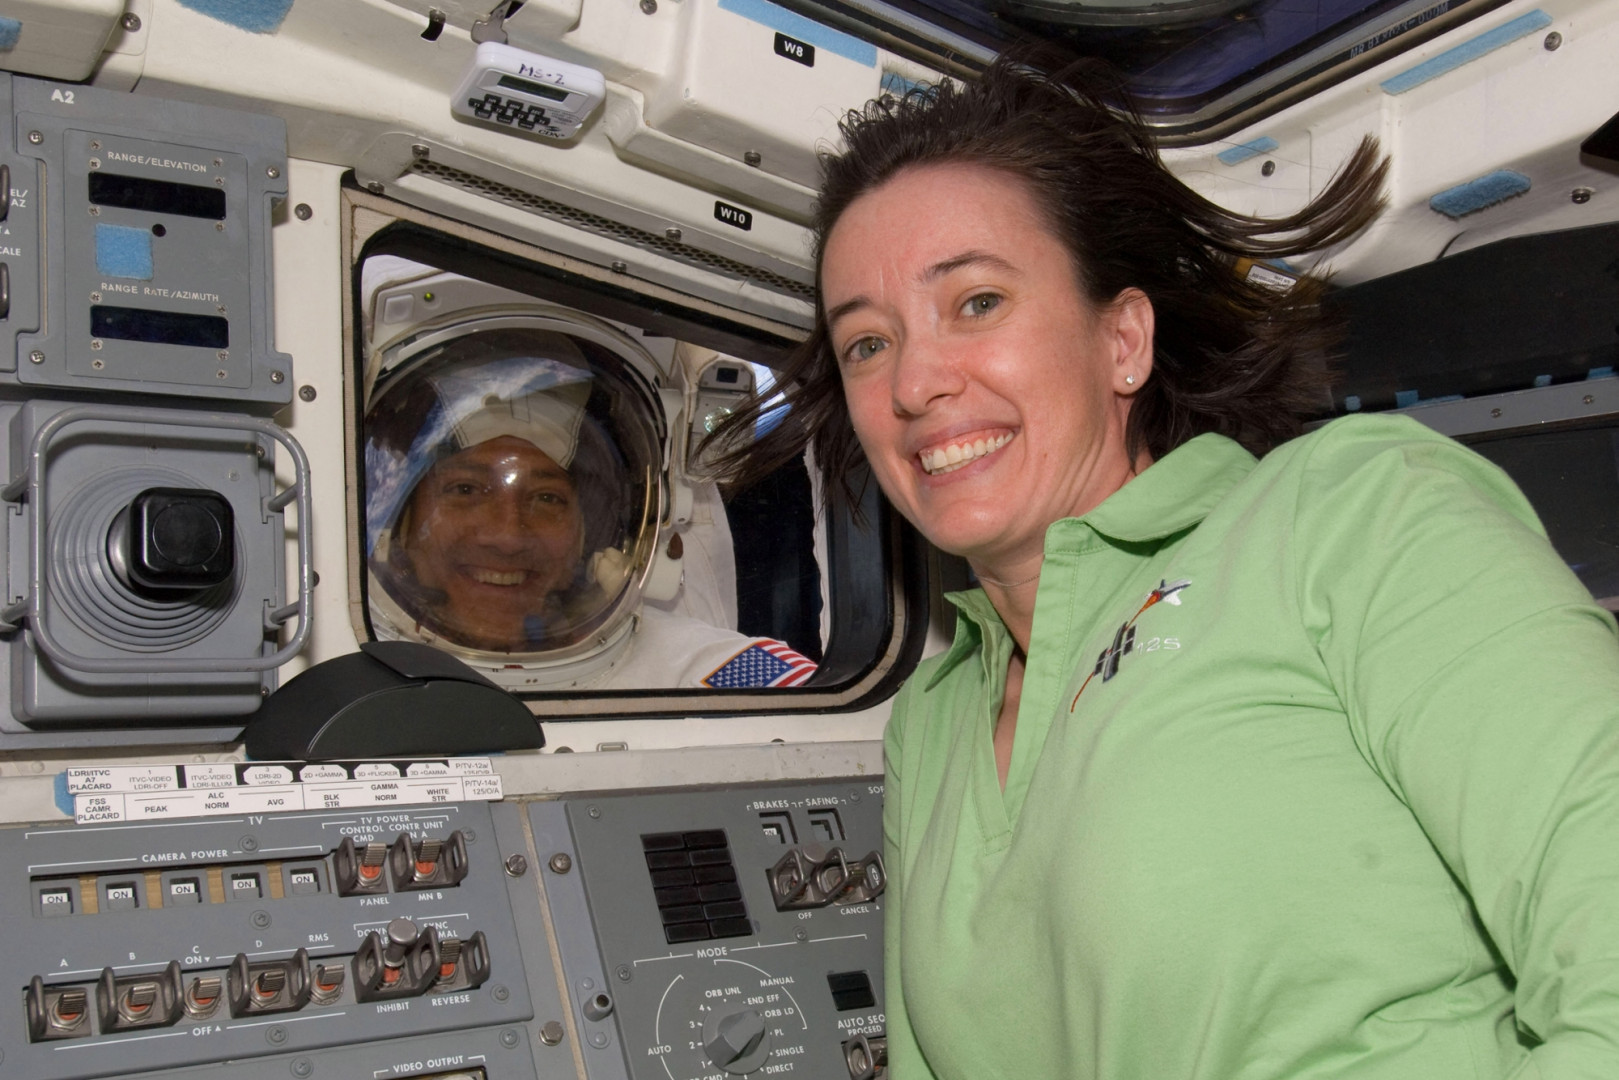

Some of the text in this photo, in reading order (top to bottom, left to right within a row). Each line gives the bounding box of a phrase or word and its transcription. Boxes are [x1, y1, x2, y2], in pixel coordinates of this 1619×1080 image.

[783, 40, 804, 58] W8
[519, 63, 565, 85] MS-2
[51, 89, 74, 104] A2
[107, 151, 207, 172] RANGE/ELEVATION
[10, 188, 28, 199] EL/
[11, 198, 26, 208] AZ
[720, 205, 746, 225] W10
[101, 282, 138, 294] RANGE
[69, 769, 111, 777] LDRI/ITVC
[129, 775, 172, 783] ITVC-VIDEO
[370, 783, 399, 791] GAMMA
[753, 799, 789, 810] BRAKES
[805, 796, 839, 807] SAFING
[78, 813, 120, 821] PLACARD
[248, 816, 264, 825] TV
[360, 815, 410, 825] TV POWER
[340, 821, 444, 835] CONTROL CONTR UNIT
[353, 834, 374, 842] CMD
[142, 850, 228, 863] CAMERA POWER
[237, 880, 252, 888] ON
[296, 875, 310, 883] ON
[176, 885, 191, 894] ON
[47, 895, 63, 904] ON
[113, 891, 128, 899] ON
[418, 892, 443, 901] MN B
[360, 897, 390, 906] PANEL
[798, 911, 813, 920] OFF
[840, 905, 870, 916] CANCEL
[308, 933, 329, 942] RMS
[129, 952, 136, 960] B
[696, 946, 728, 958] MODE
[60, 958, 68, 967] A
[185, 955, 202, 965] ON
[759, 976, 795, 988] MANUAL
[705, 986, 742, 998] ORB UNL
[431, 994, 470, 1007] REVERSE
[748, 993, 780, 1005] END EFF
[376, 1002, 410, 1014] INHIBIT
[699, 1004, 705, 1013] 4
[764, 1006, 795, 1018] ORB LD
[689, 1020, 696, 1029] 3
[838, 1016, 865, 1029] AUTO
[192, 1026, 212, 1036] OFF
[774, 1028, 784, 1038] PL
[847, 1025, 882, 1036] PROCEED
[647, 1044, 672, 1056] AUTO
[689, 1041, 696, 1049] 2
[775, 1045, 805, 1057] SINGLE
[393, 1055, 464, 1073] VIDEO OUTPUT
[766, 1062, 795, 1074] DIRECT
